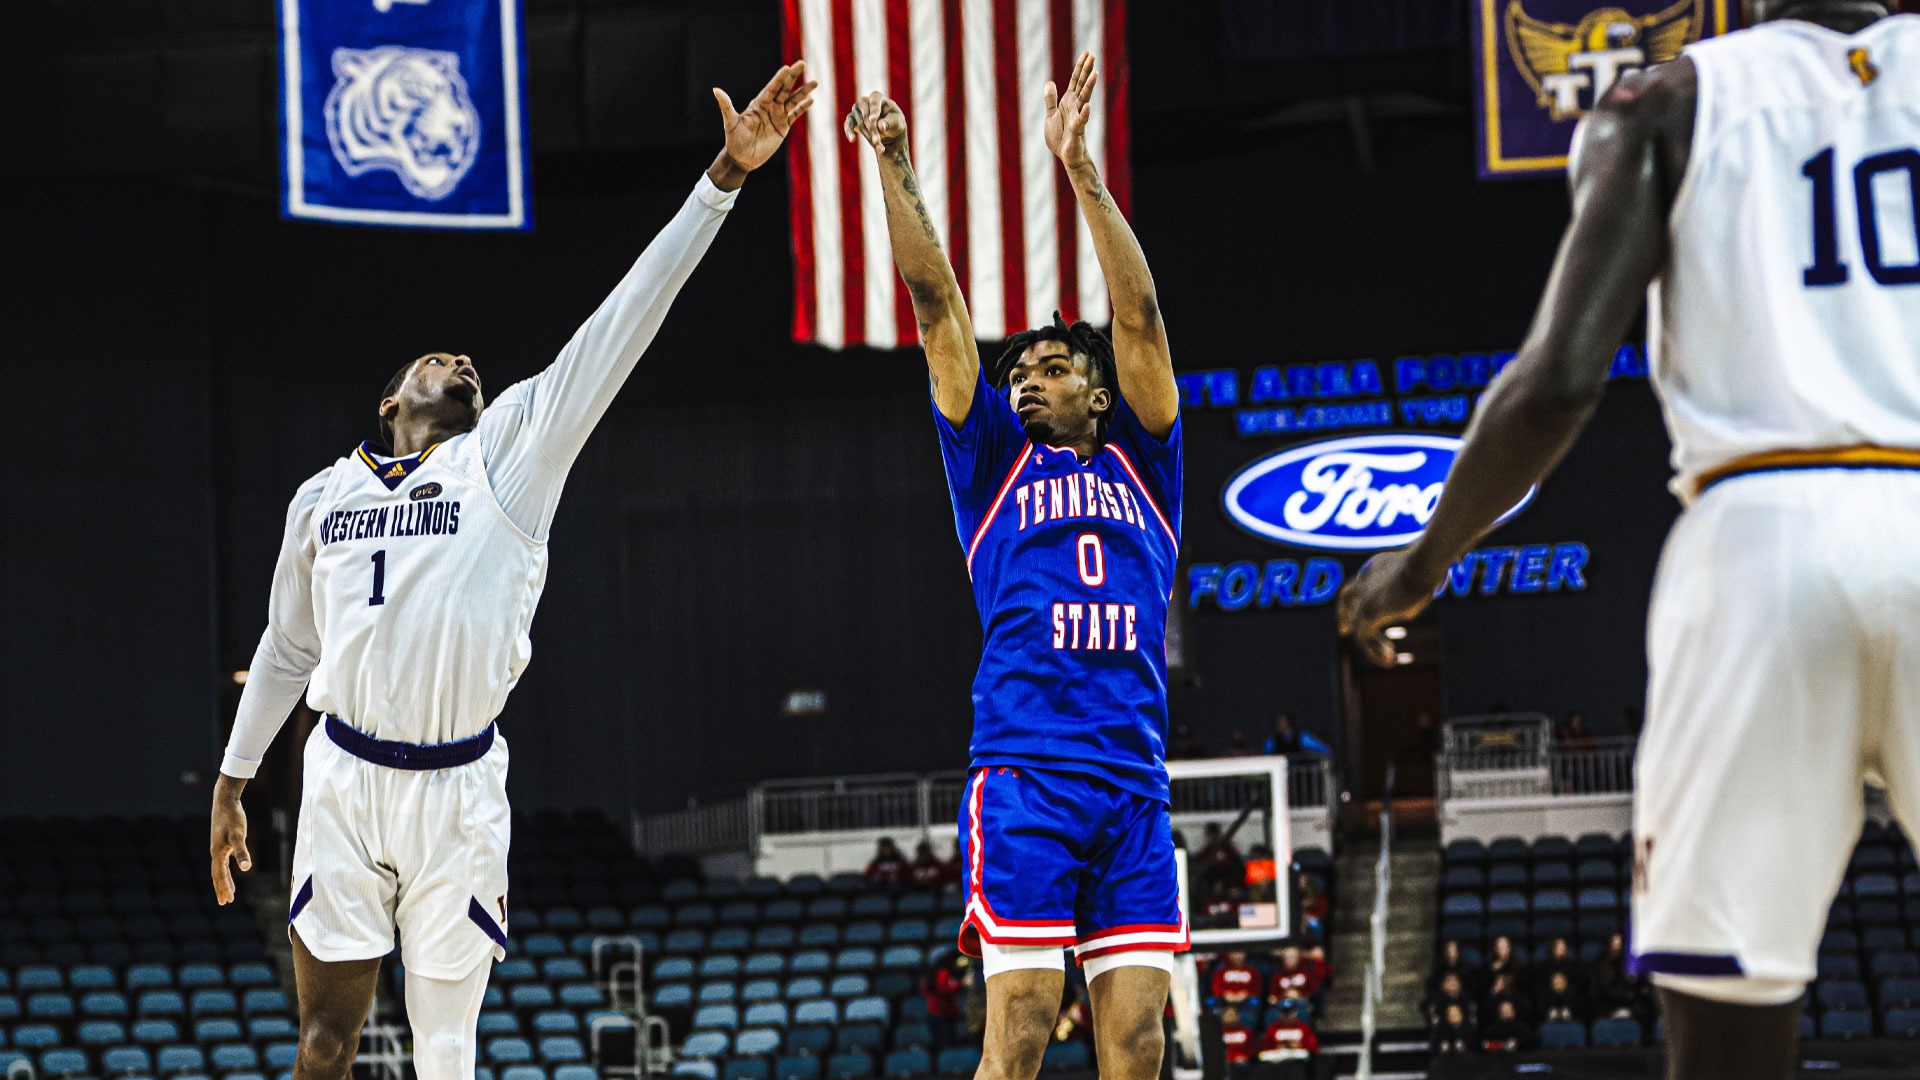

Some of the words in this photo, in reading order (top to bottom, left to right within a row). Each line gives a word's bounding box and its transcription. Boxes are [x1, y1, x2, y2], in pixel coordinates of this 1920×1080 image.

[1802, 147, 1920, 286] 10
[320, 506, 390, 546] WESTERN
[390, 501, 461, 537] ILLINOIS
[369, 550, 386, 607] 1
[1076, 532, 1105, 586] 0
[1189, 558, 1344, 611] FORD
[1052, 602, 1137, 651] STATE
